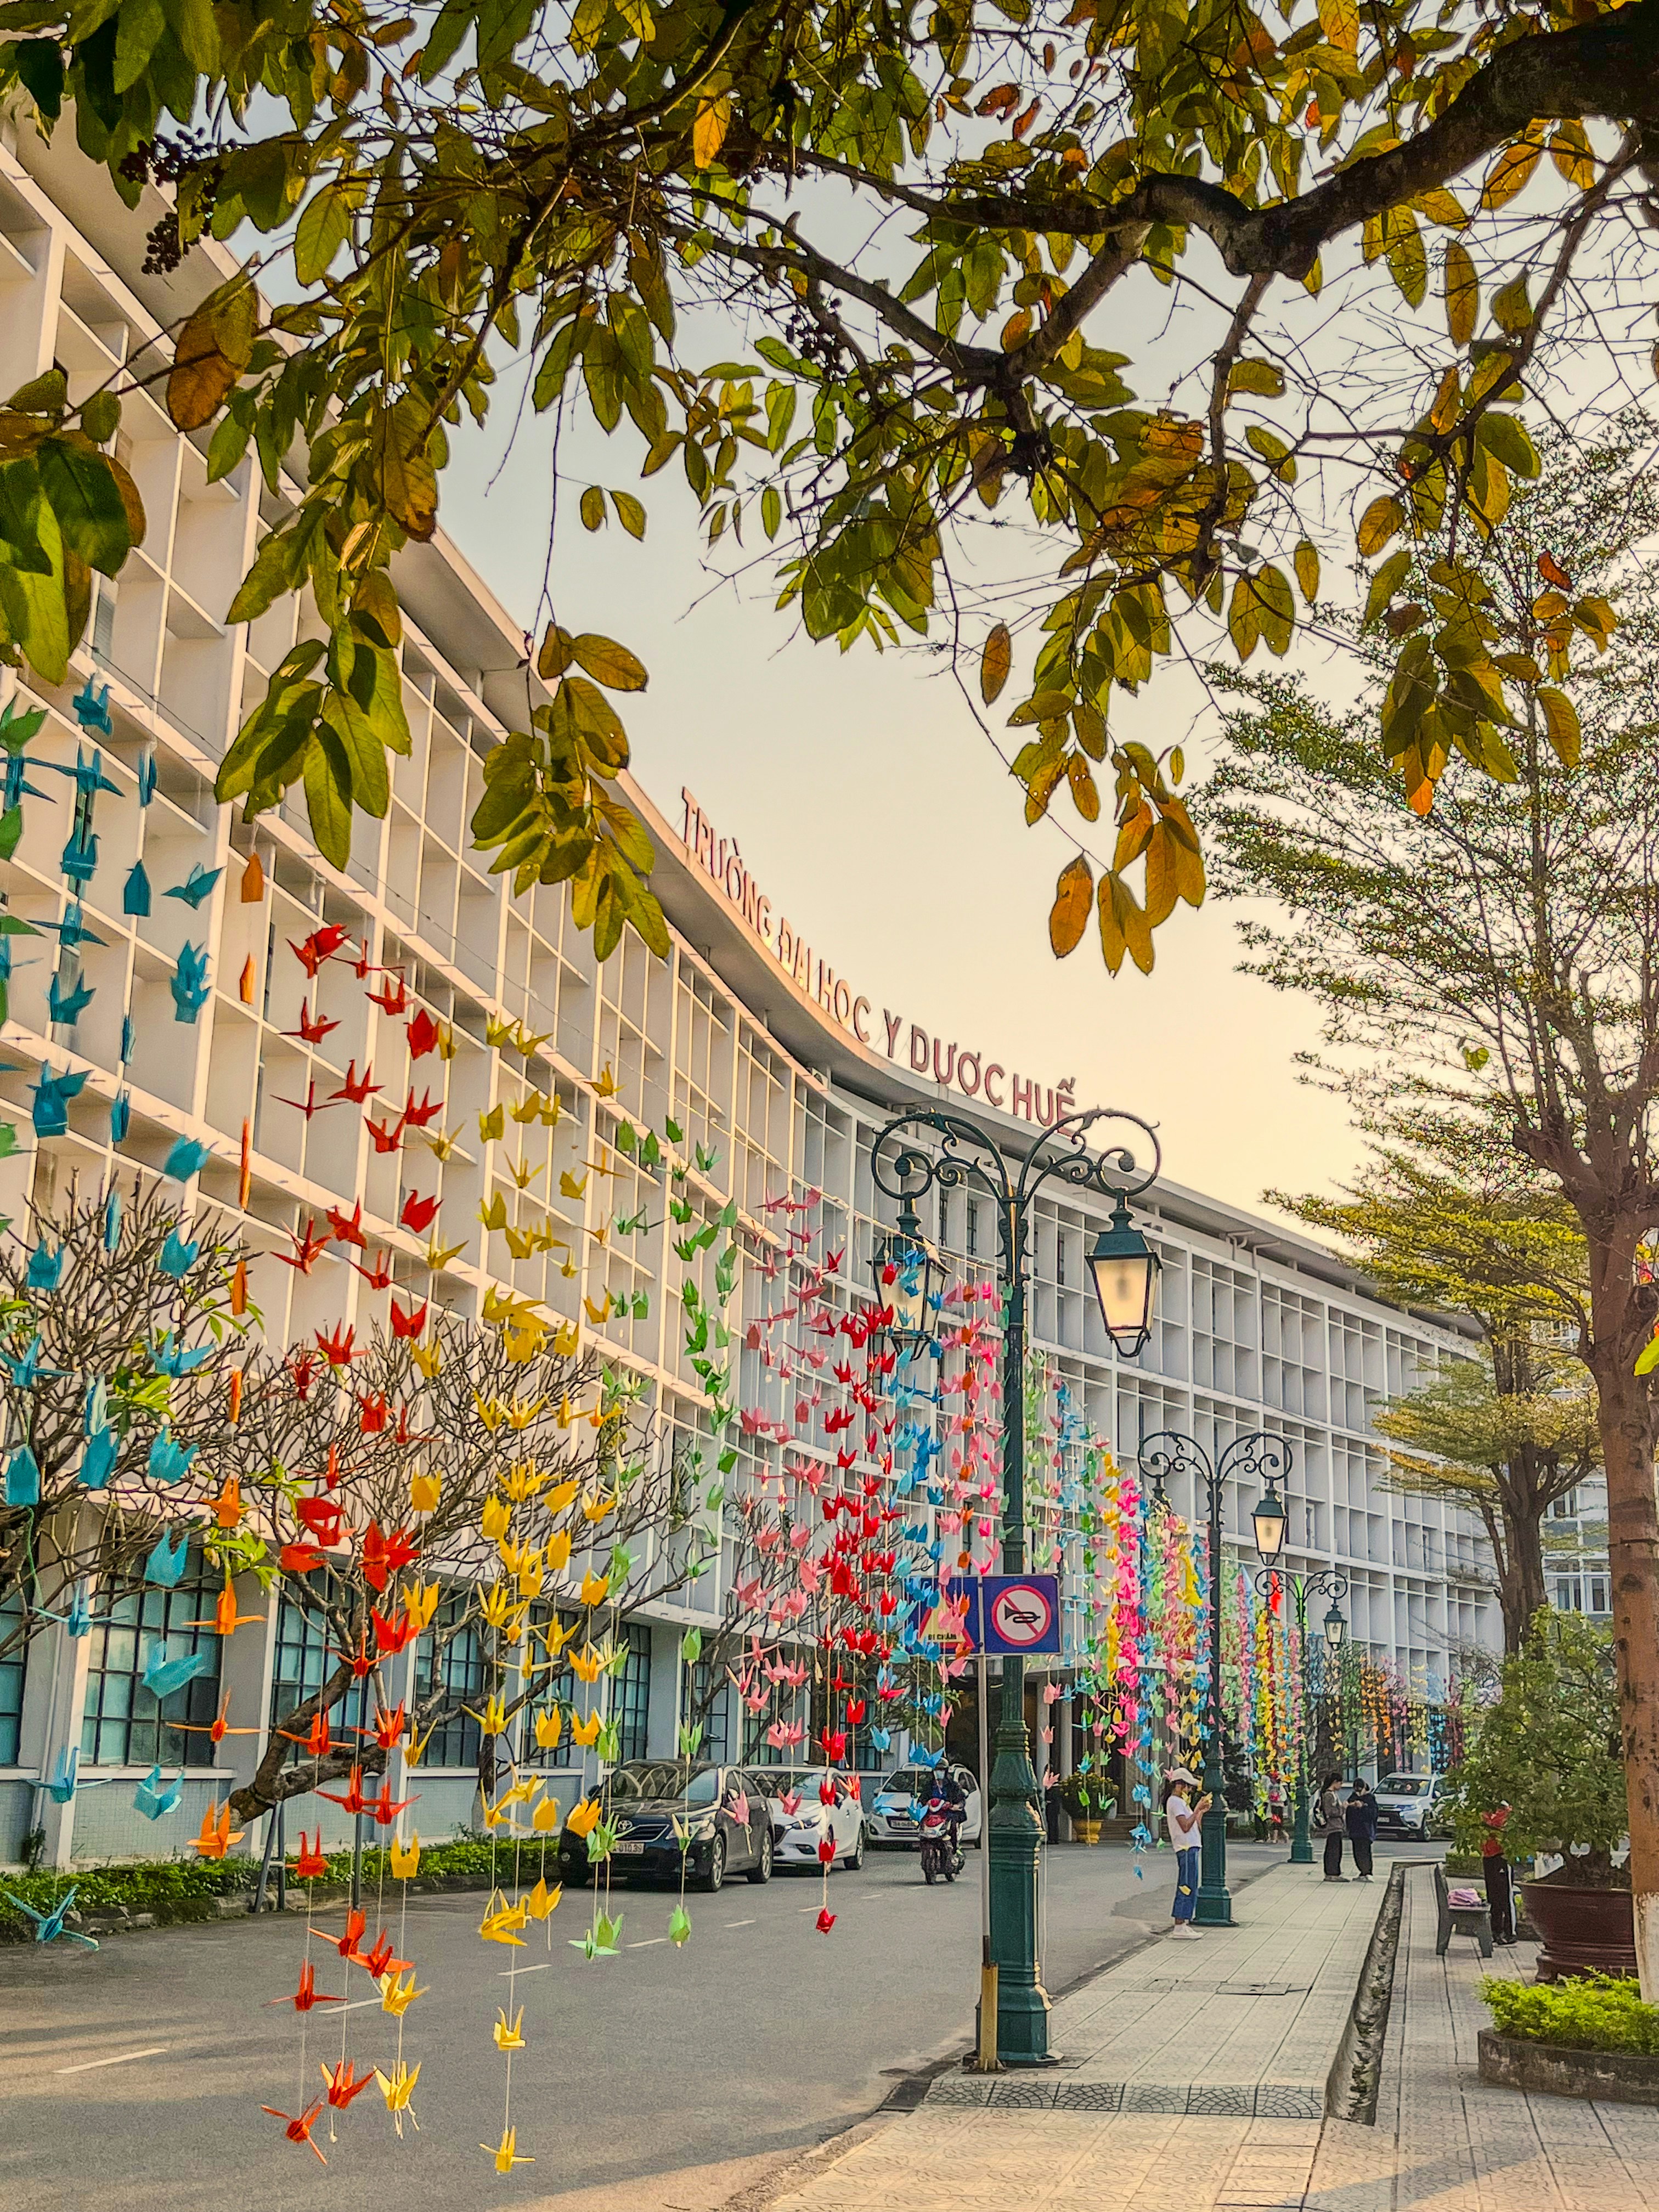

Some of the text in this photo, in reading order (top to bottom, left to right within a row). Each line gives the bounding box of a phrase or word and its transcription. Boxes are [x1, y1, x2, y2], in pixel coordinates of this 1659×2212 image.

[682, 786, 1076, 1137] TRƯỜNG ĐẠI HỌC Y DƯỢC HUẾ
